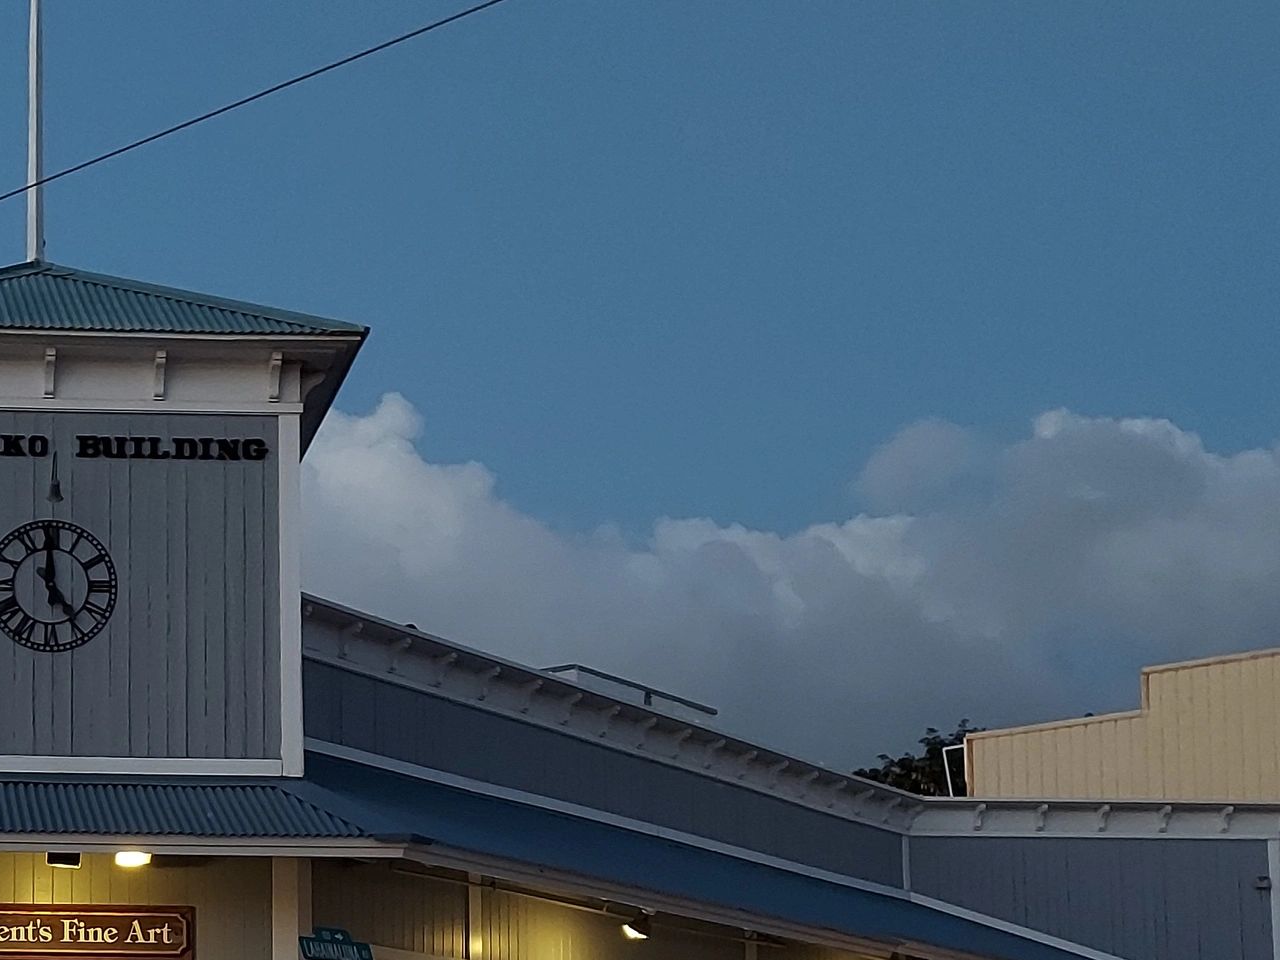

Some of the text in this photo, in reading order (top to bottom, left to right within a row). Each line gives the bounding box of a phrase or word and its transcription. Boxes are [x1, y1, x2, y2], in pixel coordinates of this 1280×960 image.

[75, 434, 270, 461] BUILDING
[60, 919, 118, 943] Fine
[124, 920, 172, 944] Art
